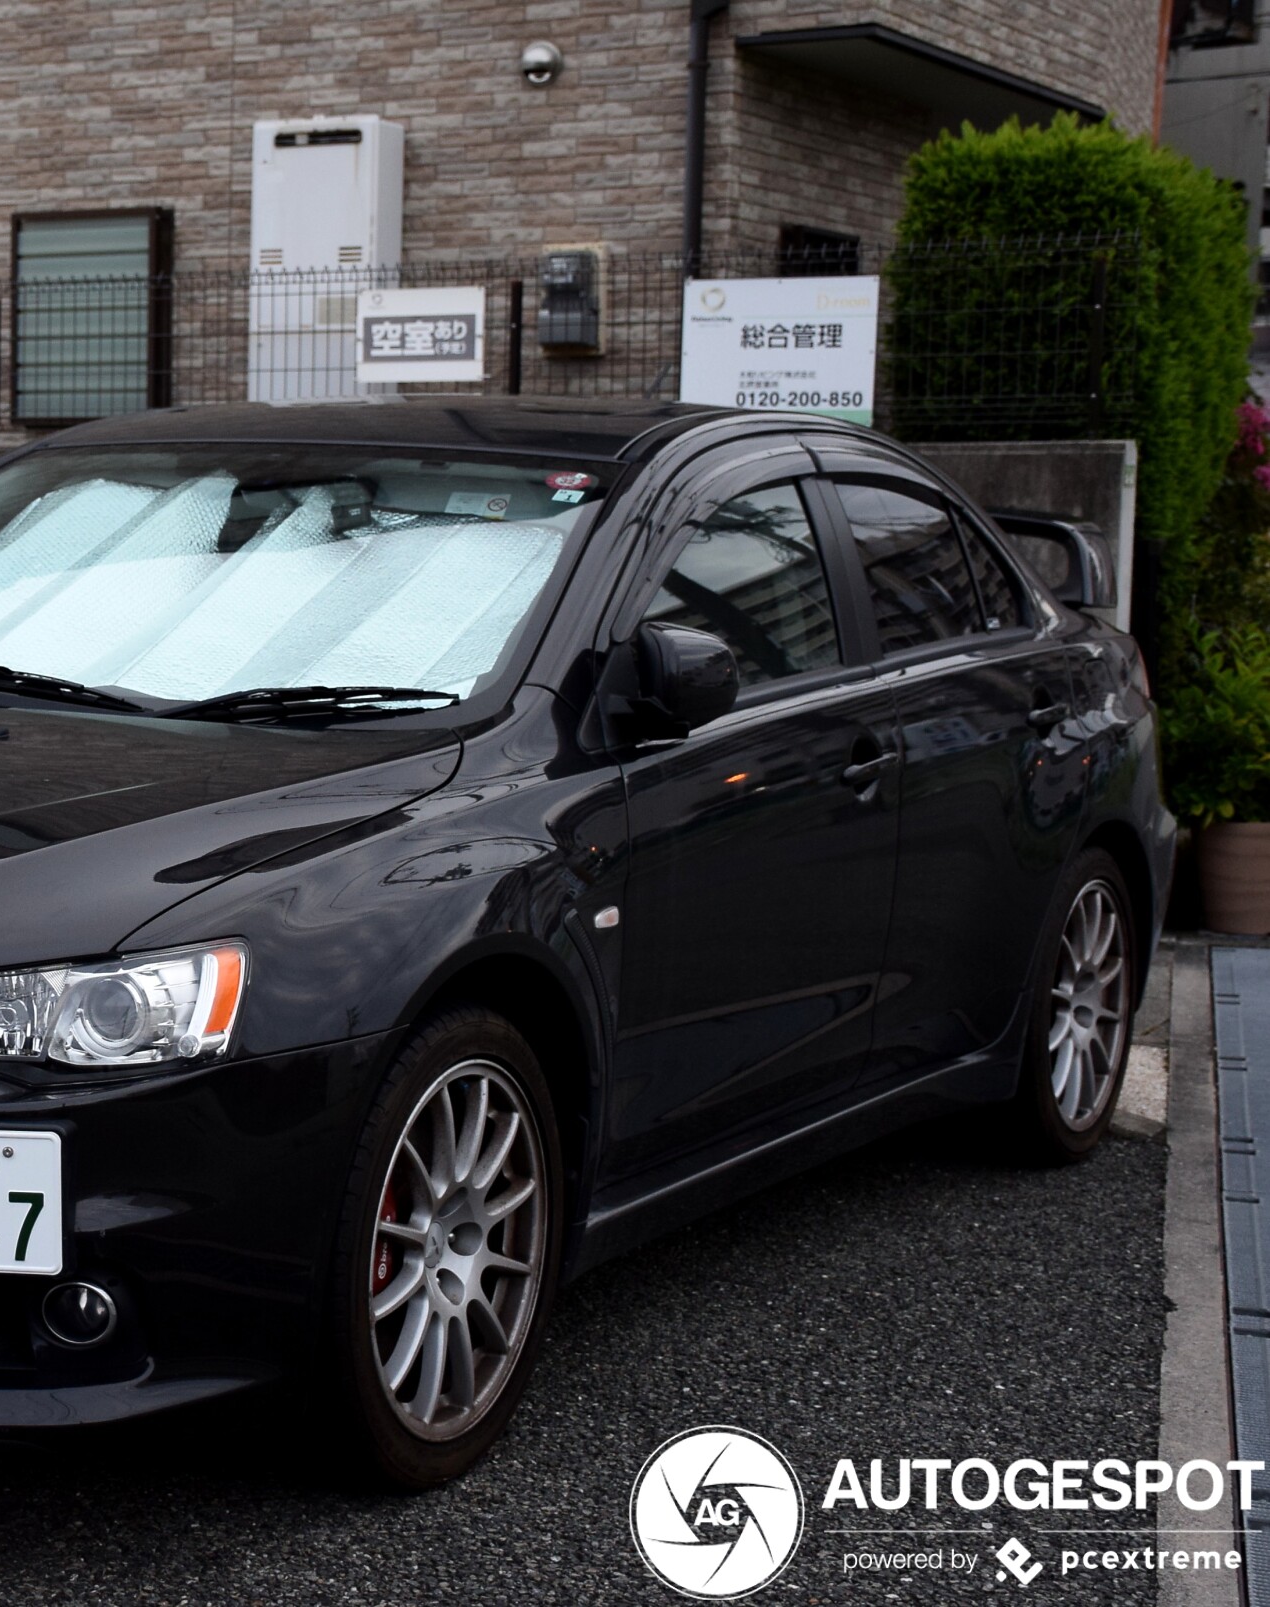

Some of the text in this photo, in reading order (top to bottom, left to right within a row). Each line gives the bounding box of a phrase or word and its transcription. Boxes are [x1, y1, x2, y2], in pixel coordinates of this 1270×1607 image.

[370, 319, 467, 356] 空室あり
[740, 323, 843, 349] 総合管理
[736, 391, 863, 407] 0120-200-850
